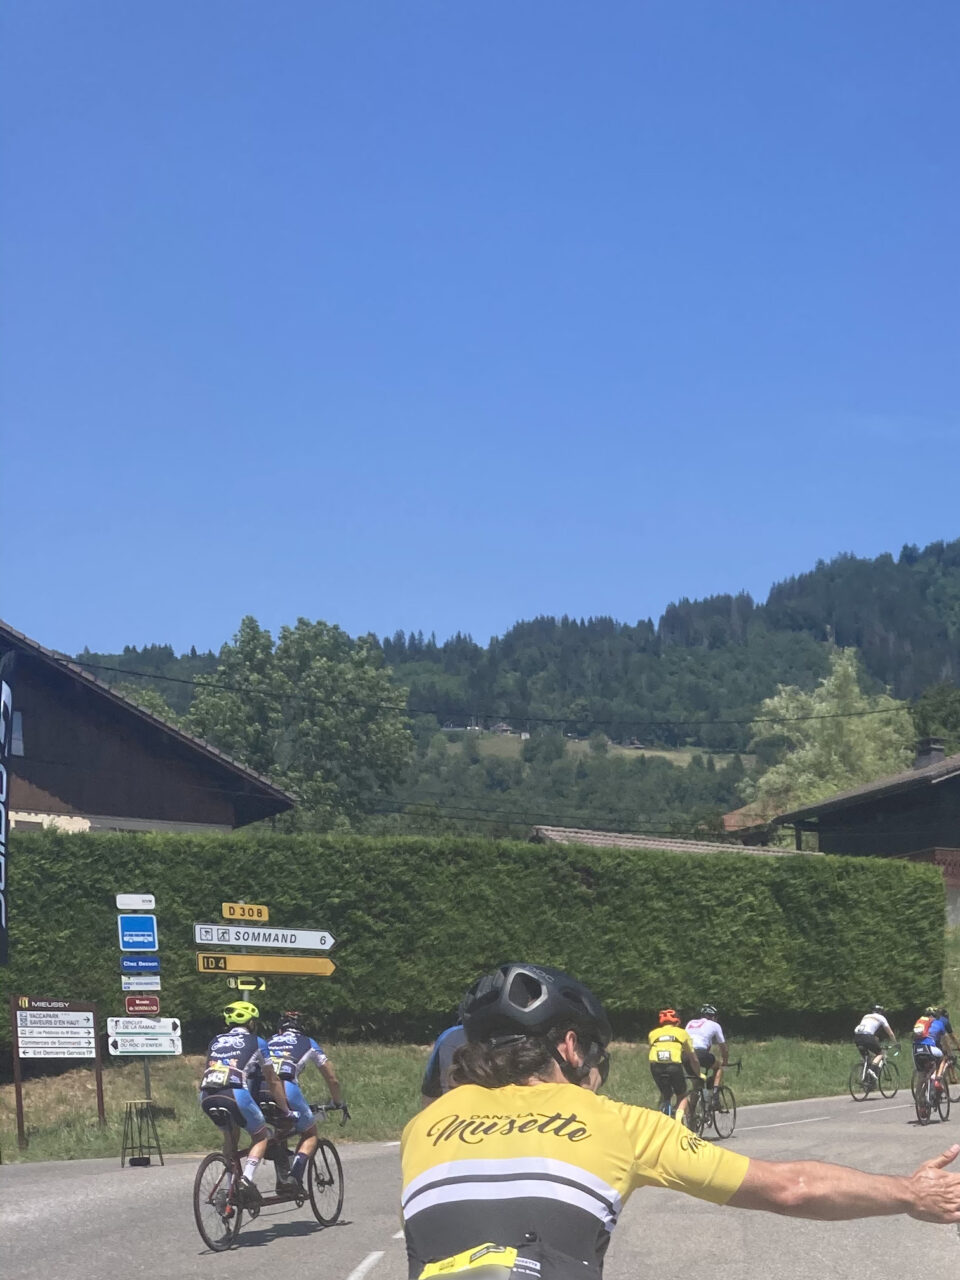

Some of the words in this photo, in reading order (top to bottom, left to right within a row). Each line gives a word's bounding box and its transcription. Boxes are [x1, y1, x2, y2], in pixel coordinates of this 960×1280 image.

[229, 906, 236, 916] D
[240, 907, 263, 918] 308
[234, 931, 297, 944] SOMMAND
[319, 935, 327, 946] 6
[426, 1112, 593, 1147] Musette
